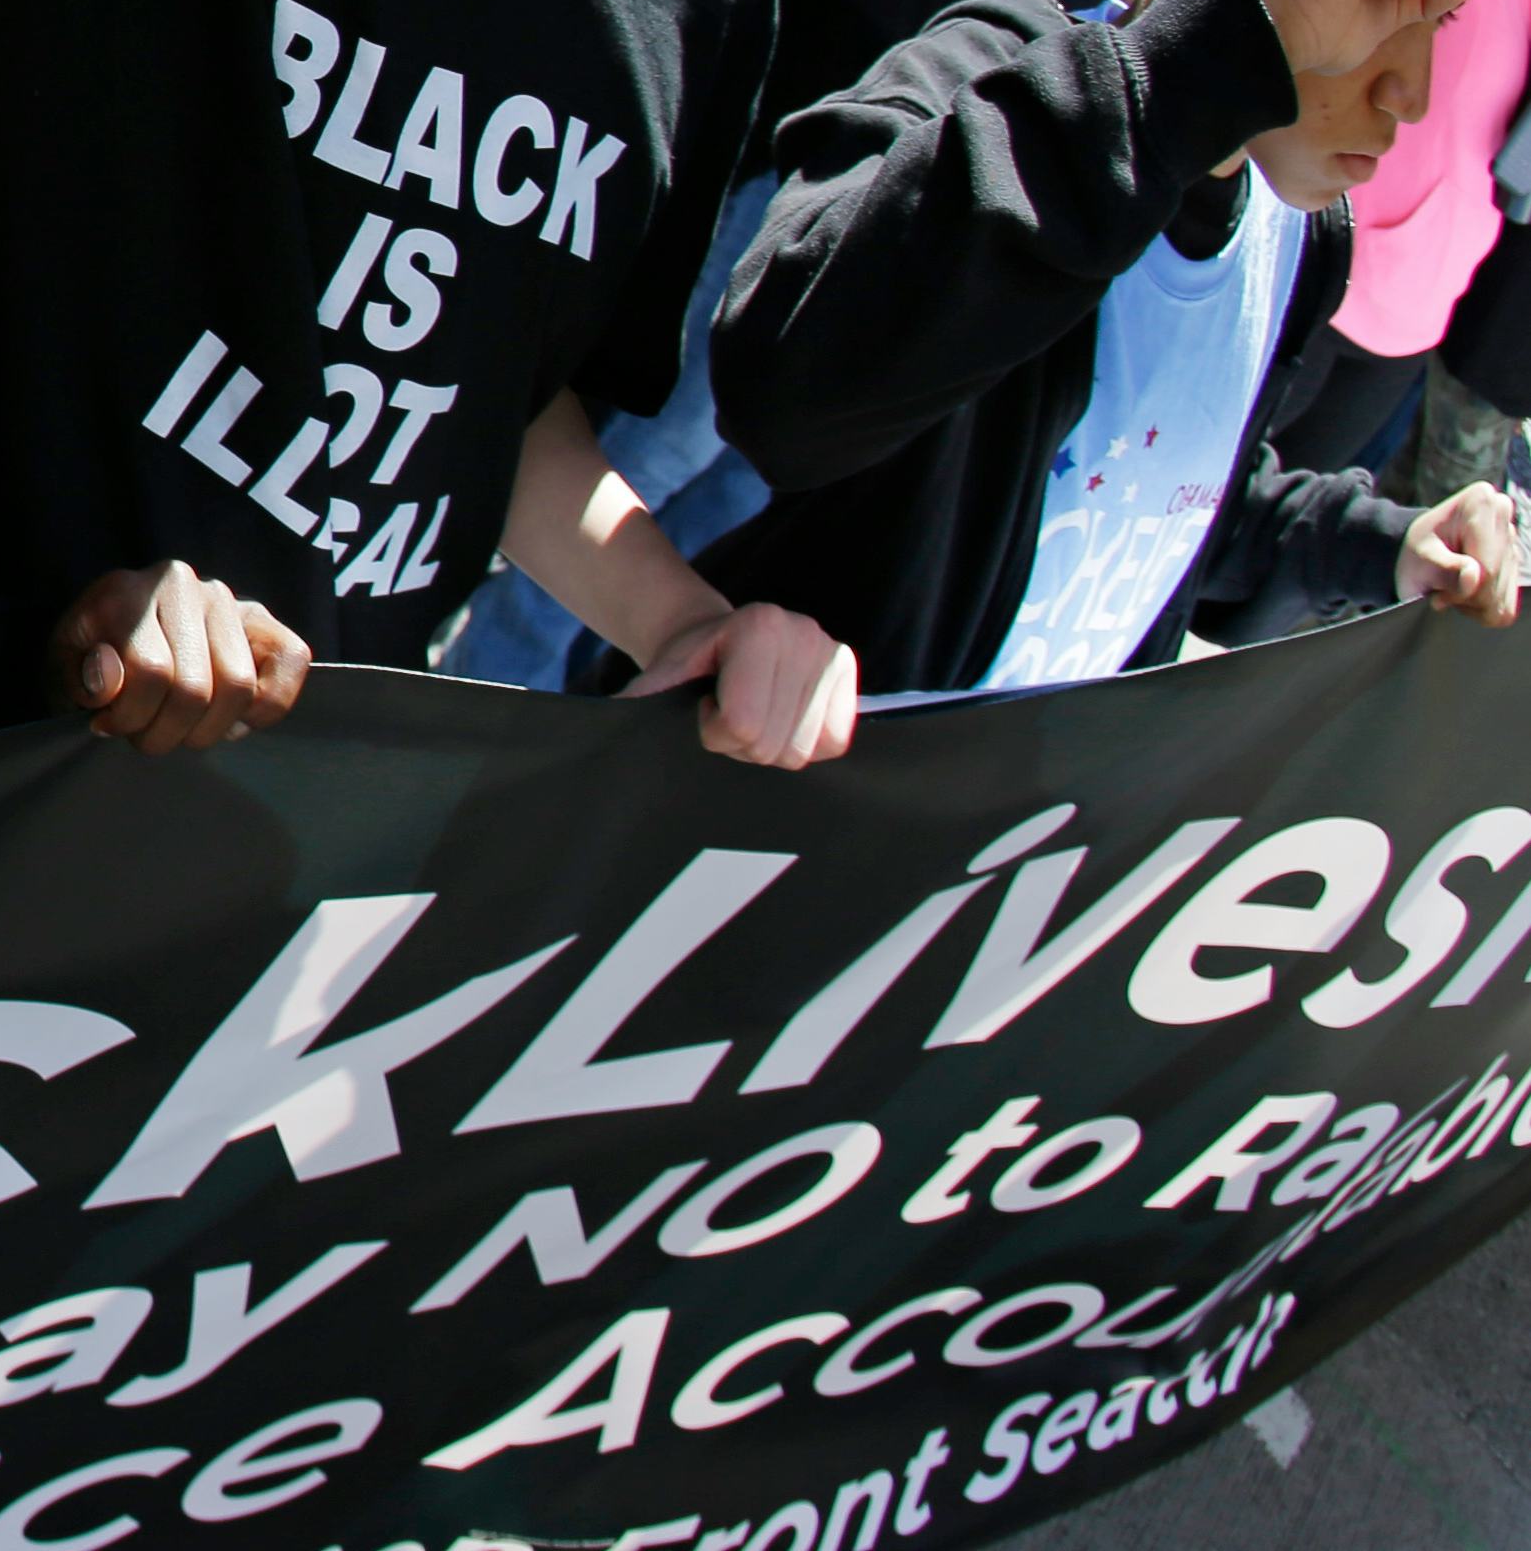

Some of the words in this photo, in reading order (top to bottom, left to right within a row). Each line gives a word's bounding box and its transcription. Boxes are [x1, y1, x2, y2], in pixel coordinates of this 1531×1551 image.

[317, 212, 458, 352] IS
[323, 363, 458, 486] OT
[410, 1121, 881, 1314] NO
[900, 1095, 1141, 1224] to
